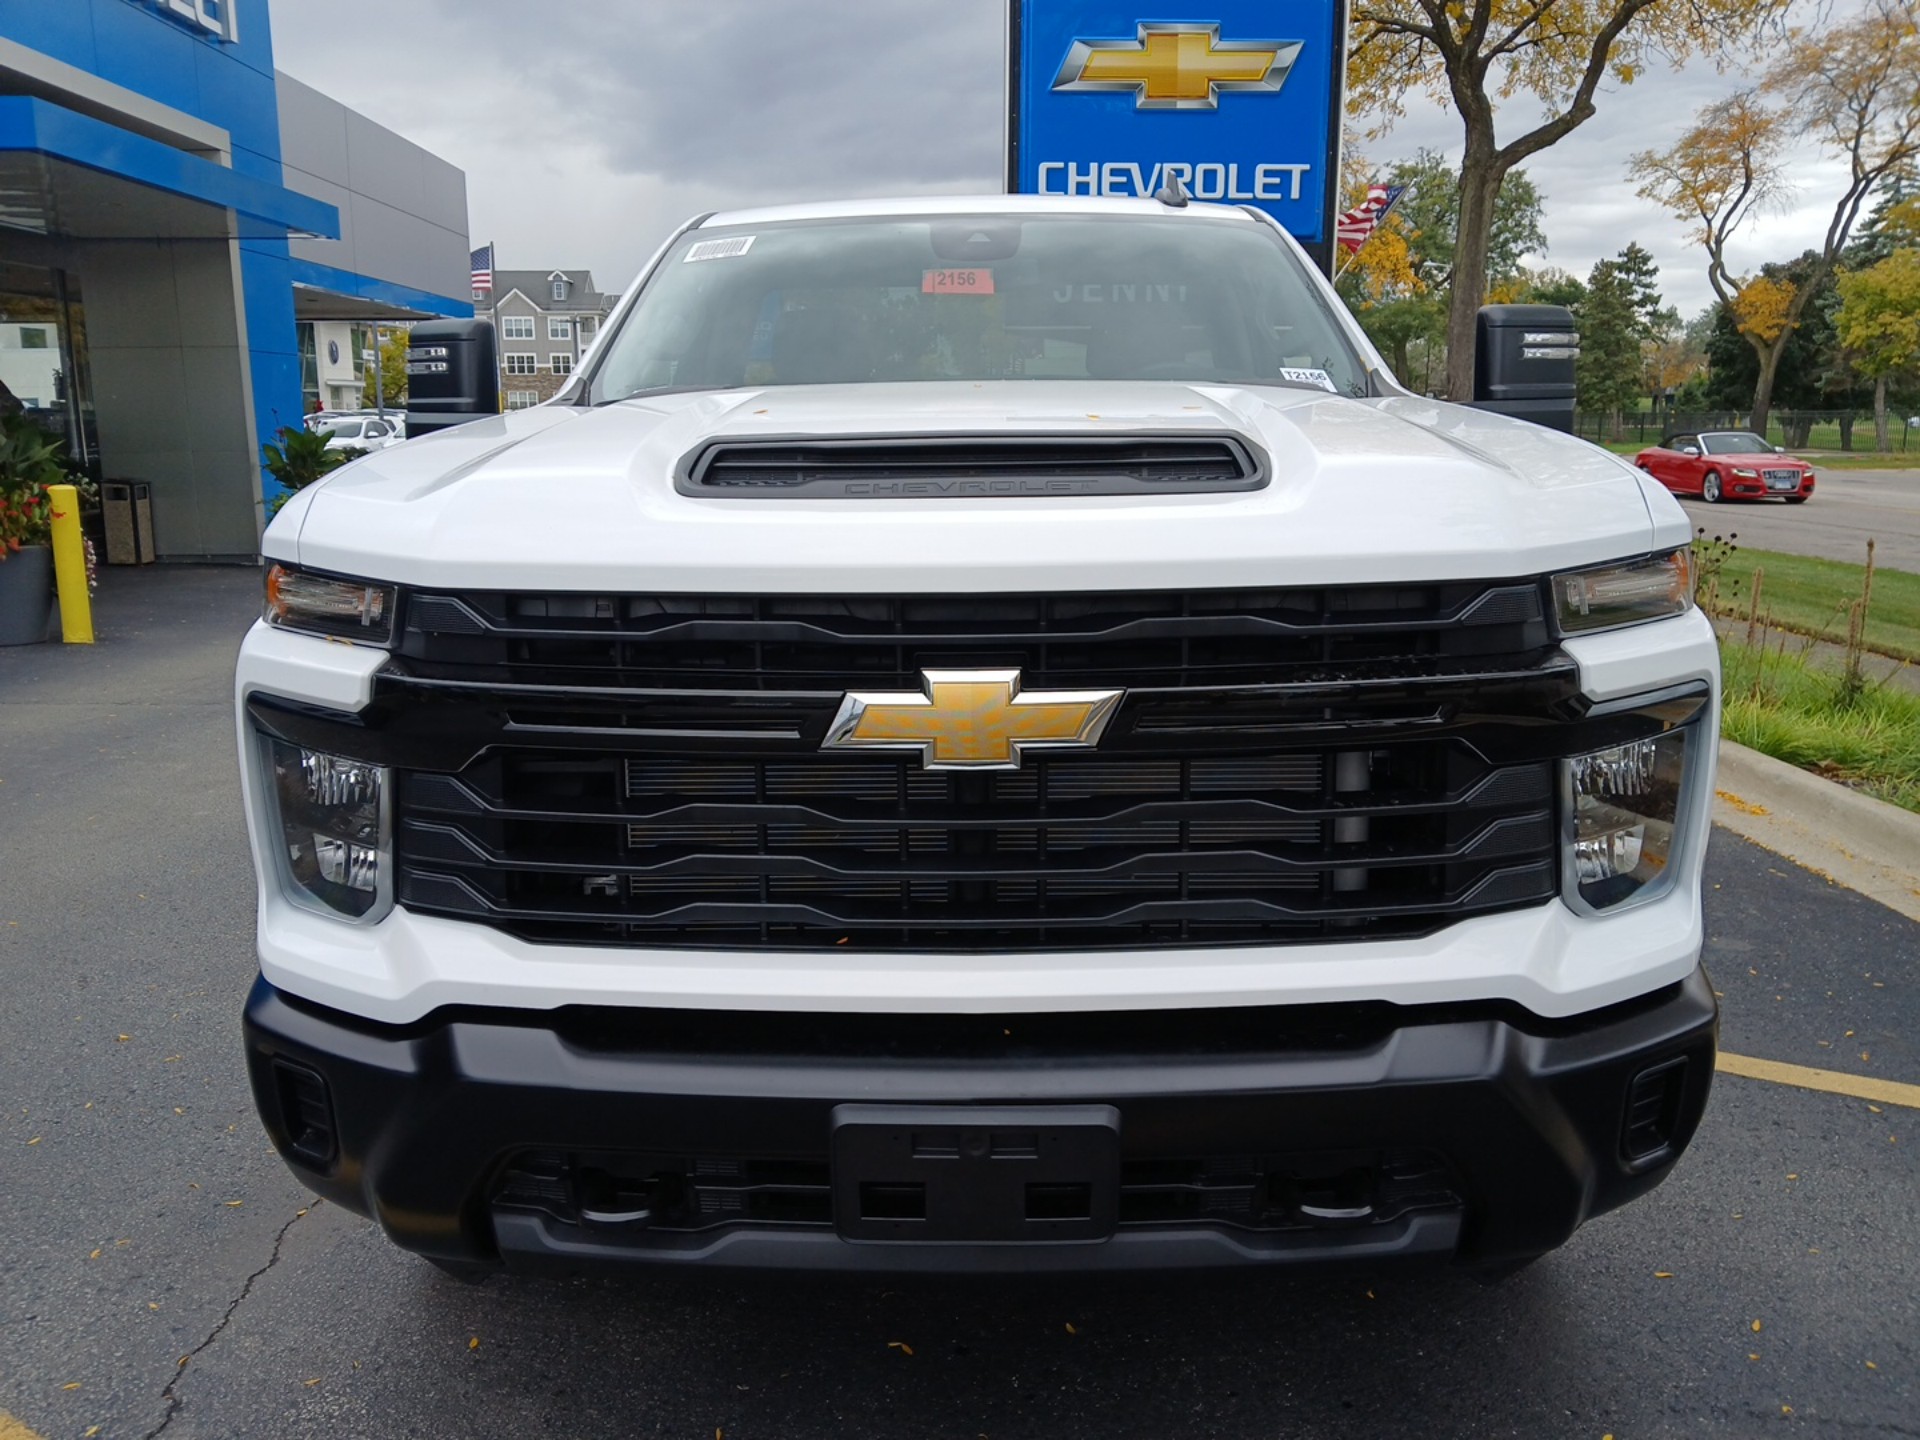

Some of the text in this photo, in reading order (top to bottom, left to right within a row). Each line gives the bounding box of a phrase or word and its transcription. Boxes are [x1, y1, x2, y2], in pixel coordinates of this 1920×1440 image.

[1038, 161, 1311, 200] CHEVROLET
[937, 271, 976, 286] 2156
[844, 480, 1099, 495] CHEVROLET
